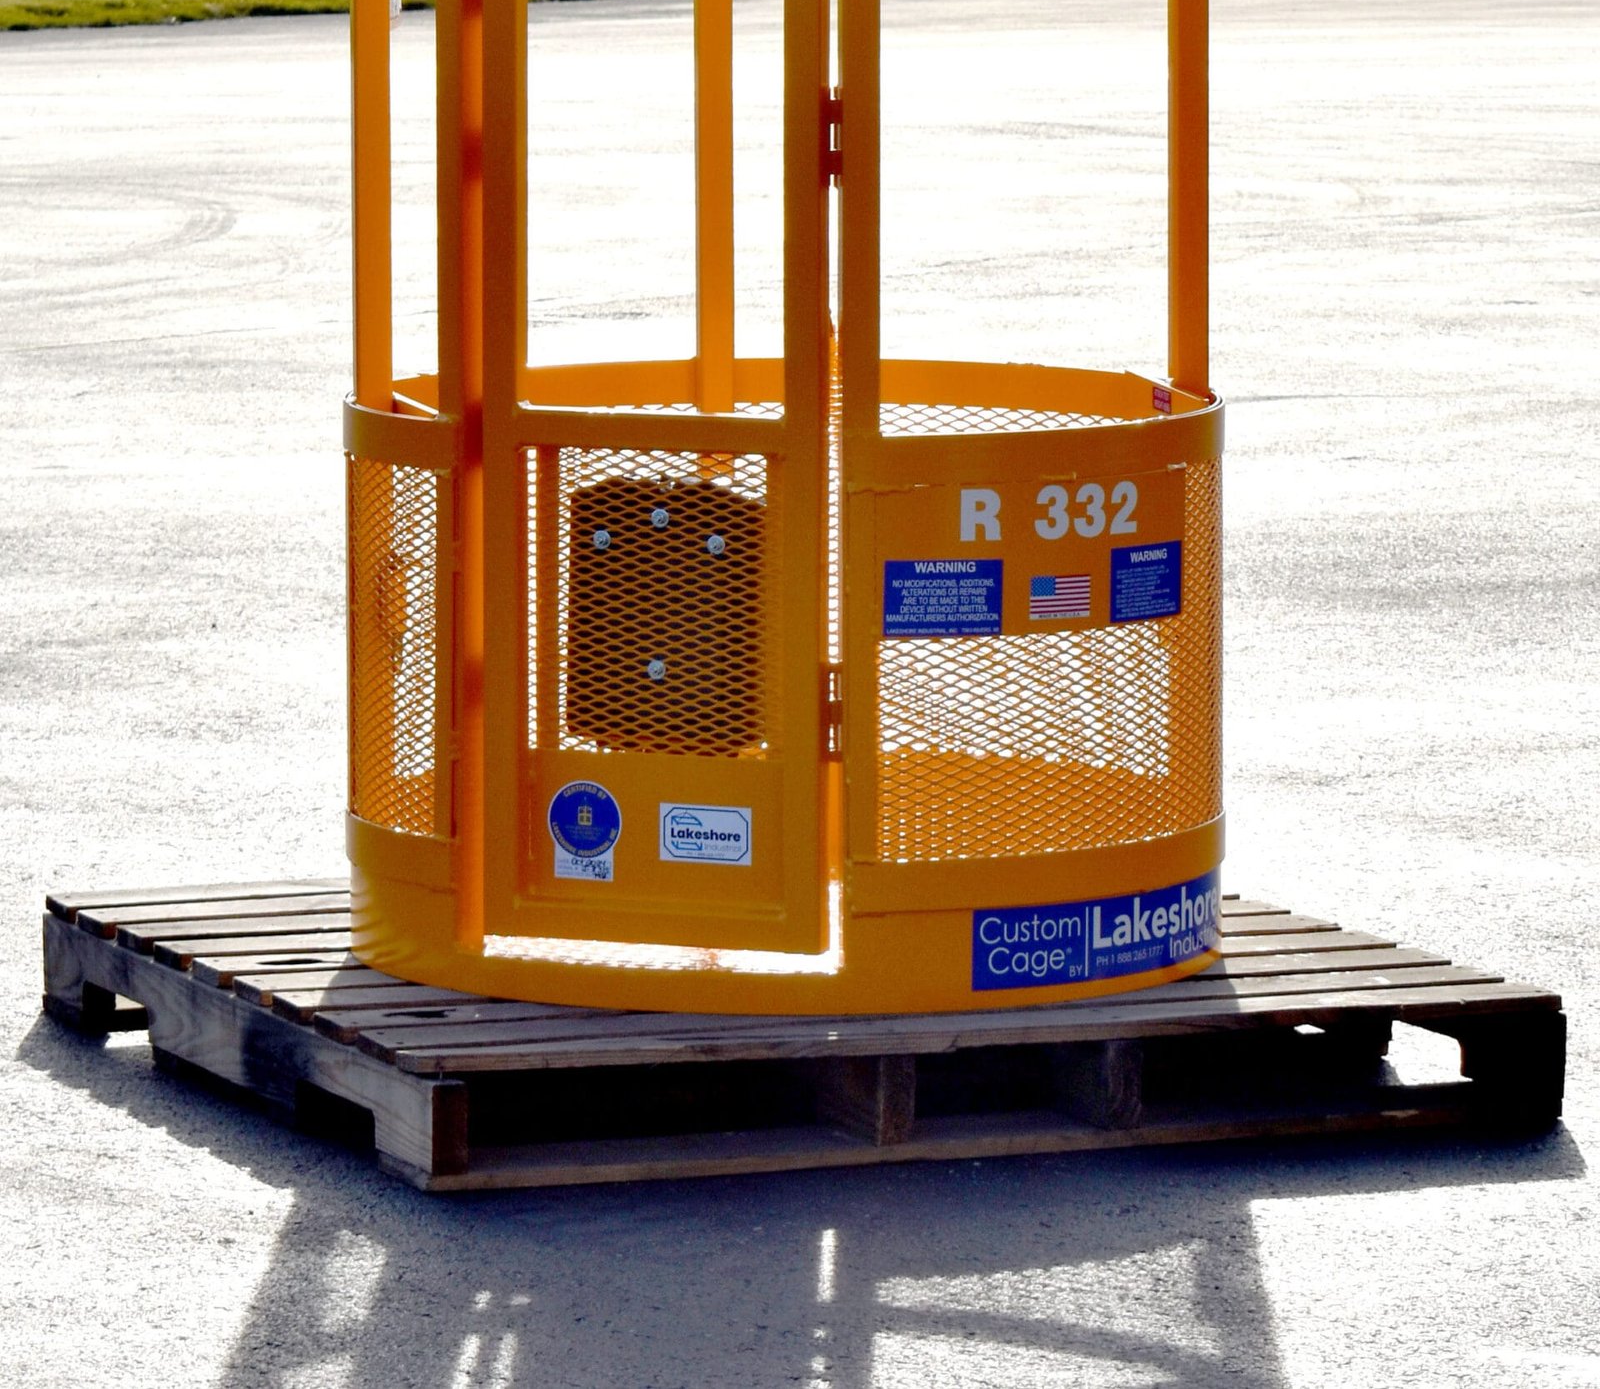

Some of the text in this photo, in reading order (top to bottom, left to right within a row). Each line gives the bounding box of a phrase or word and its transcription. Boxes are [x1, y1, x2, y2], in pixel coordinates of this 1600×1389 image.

[960, 480, 1137, 542] R 332
[1130, 548, 1167, 563] WARNING
[915, 562, 976, 573] WARNING
[902, 588, 947, 596] ALTERATIONS
[886, 614, 946, 622] MANUFACTURERS
[671, 827, 740, 842] Lakeshore
[1093, 886, 1217, 949] Lakeshore
[980, 914, 1080, 944] Custom
[1096, 956, 1108, 966] PH
[1117, 952, 1132, 963] 888
[1069, 965, 1082, 977] BY
